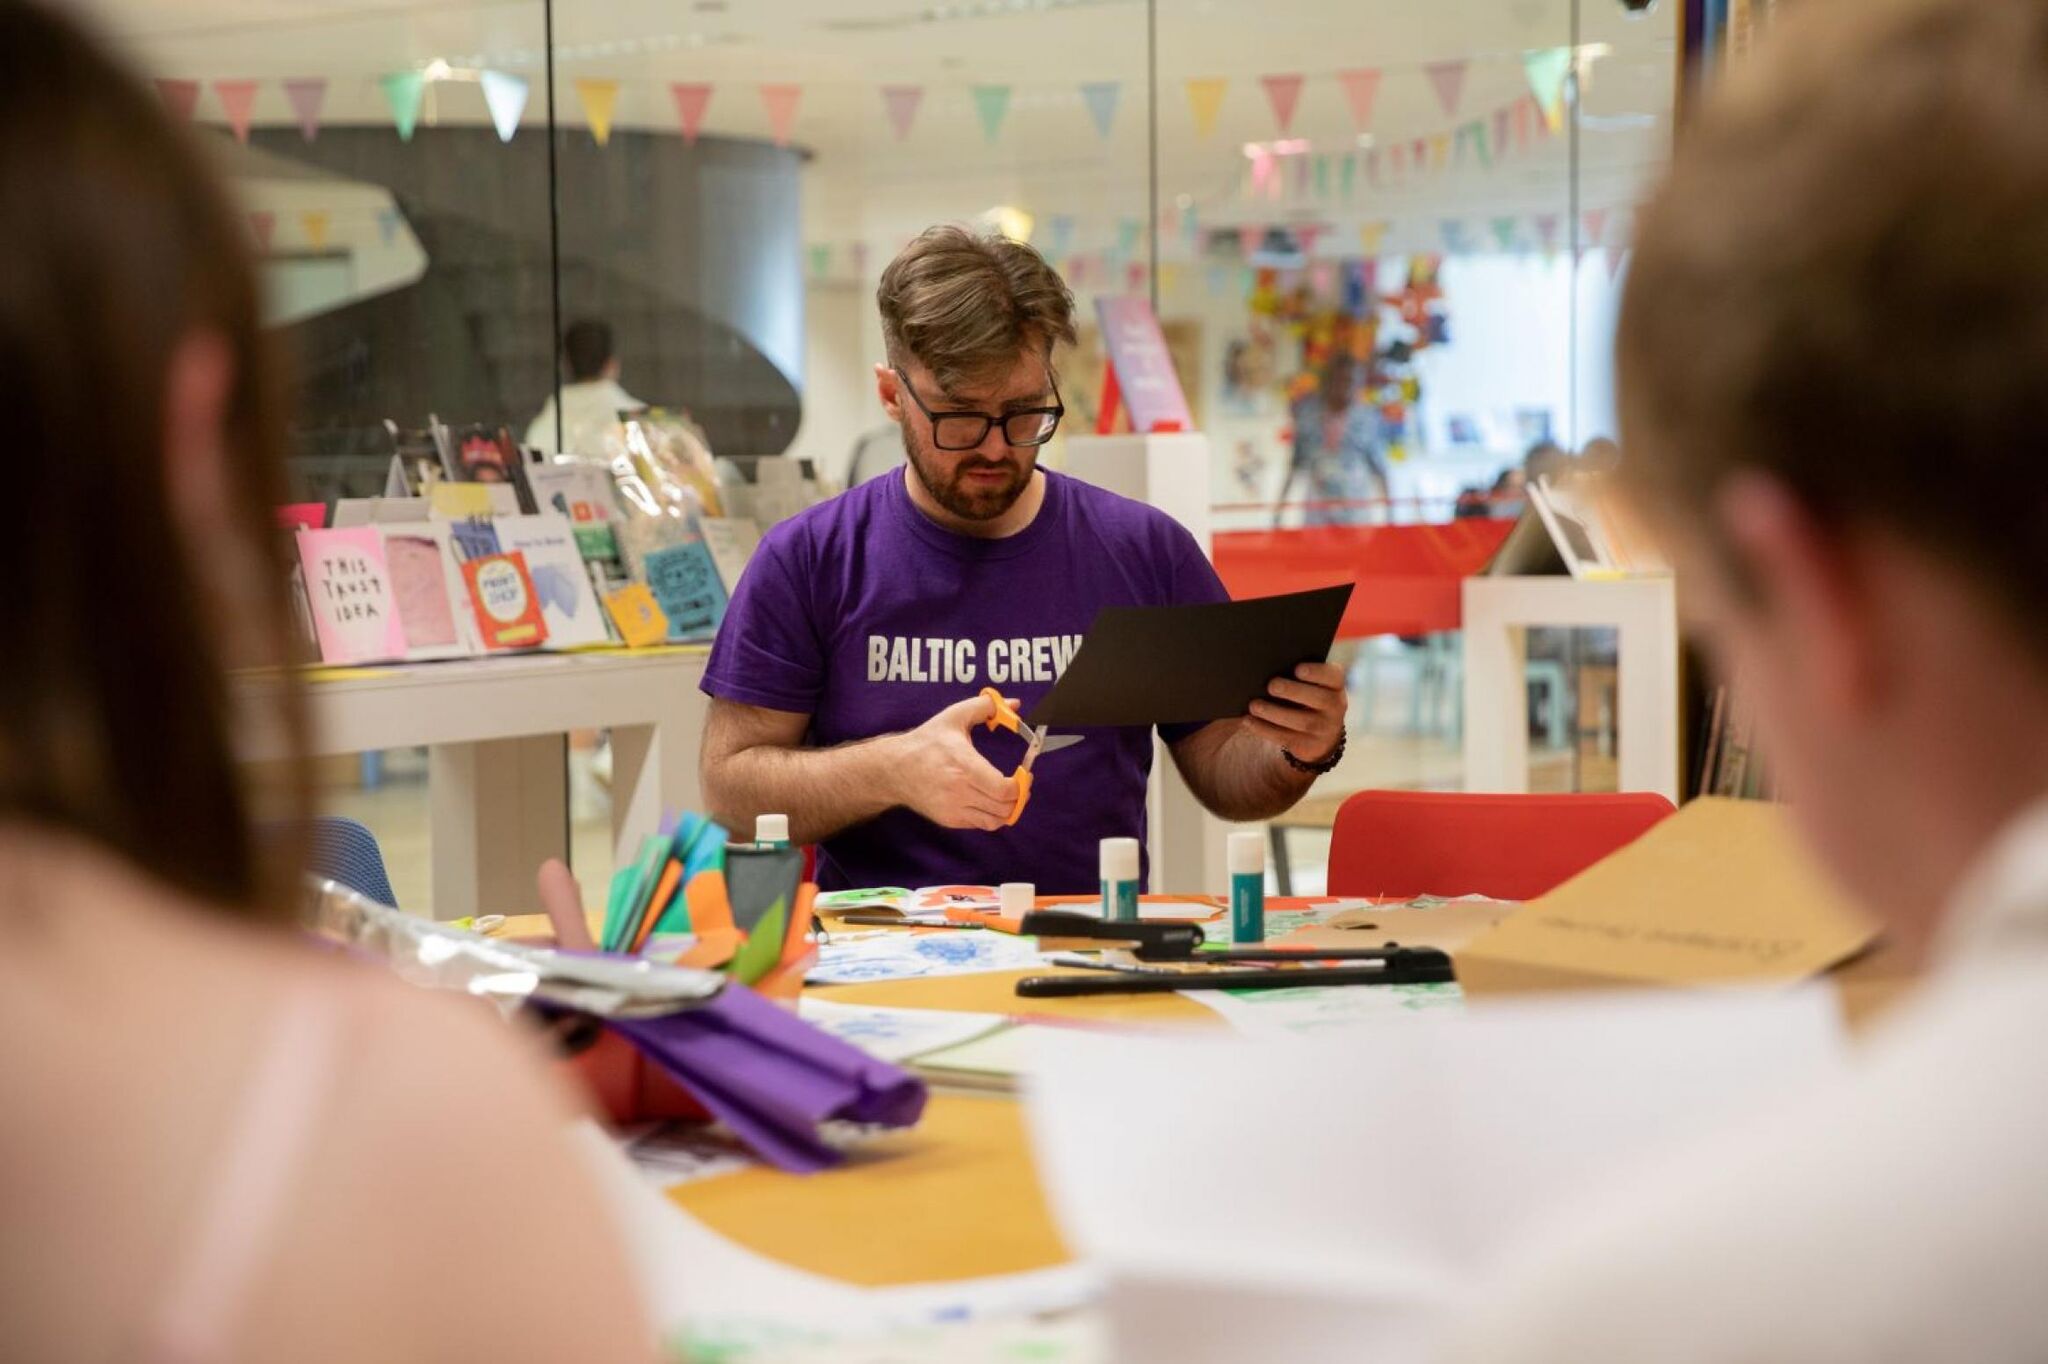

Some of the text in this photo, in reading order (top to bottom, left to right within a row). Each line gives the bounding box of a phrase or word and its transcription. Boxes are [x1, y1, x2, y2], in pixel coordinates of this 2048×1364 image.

[323, 558, 367, 576] THIS
[322, 576, 381, 600] TRUST
[335, 604, 380, 621] IDEA
[867, 635, 976, 684] BALTIC
